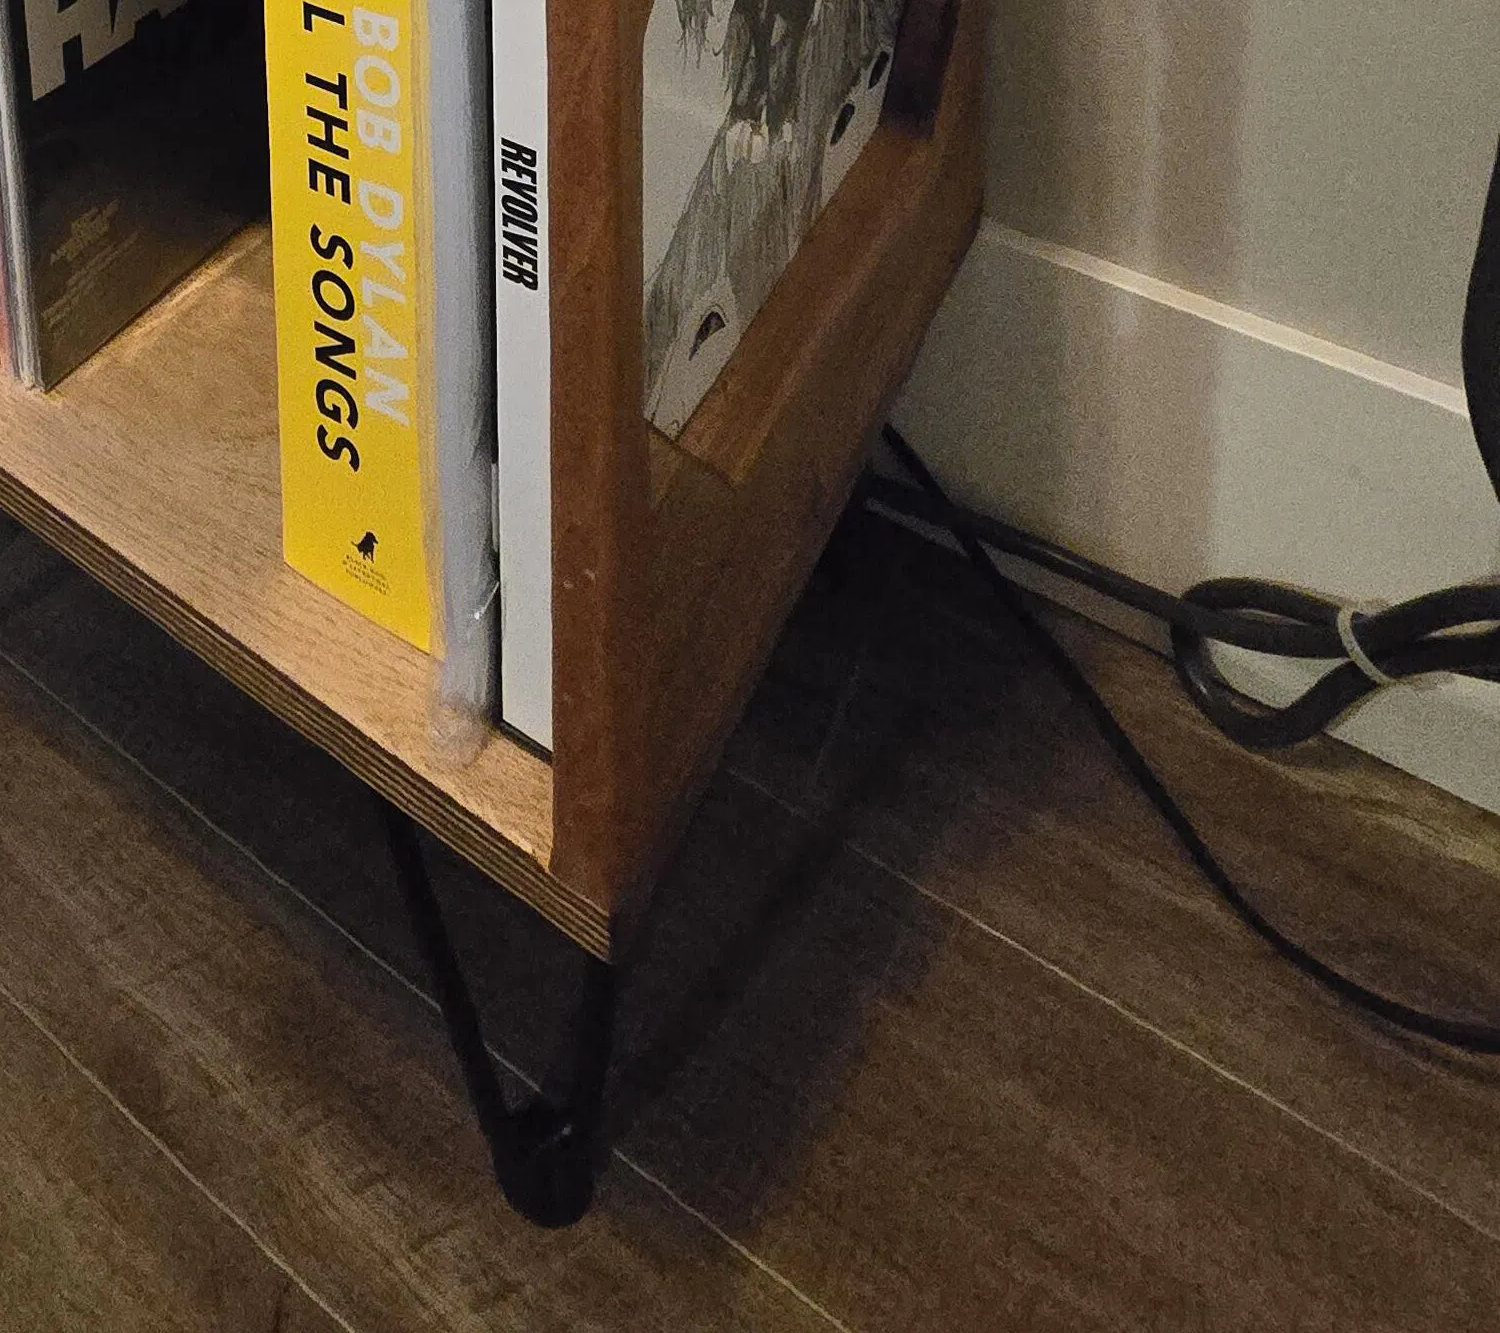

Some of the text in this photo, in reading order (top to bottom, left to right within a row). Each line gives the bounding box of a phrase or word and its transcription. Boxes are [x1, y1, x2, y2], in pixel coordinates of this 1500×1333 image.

[303, 71, 353, 196] THE
[352, 4, 411, 430] BOB DYLAN
[499, 137, 540, 293] REVOLVER
[310, 233, 362, 473] SONGS
